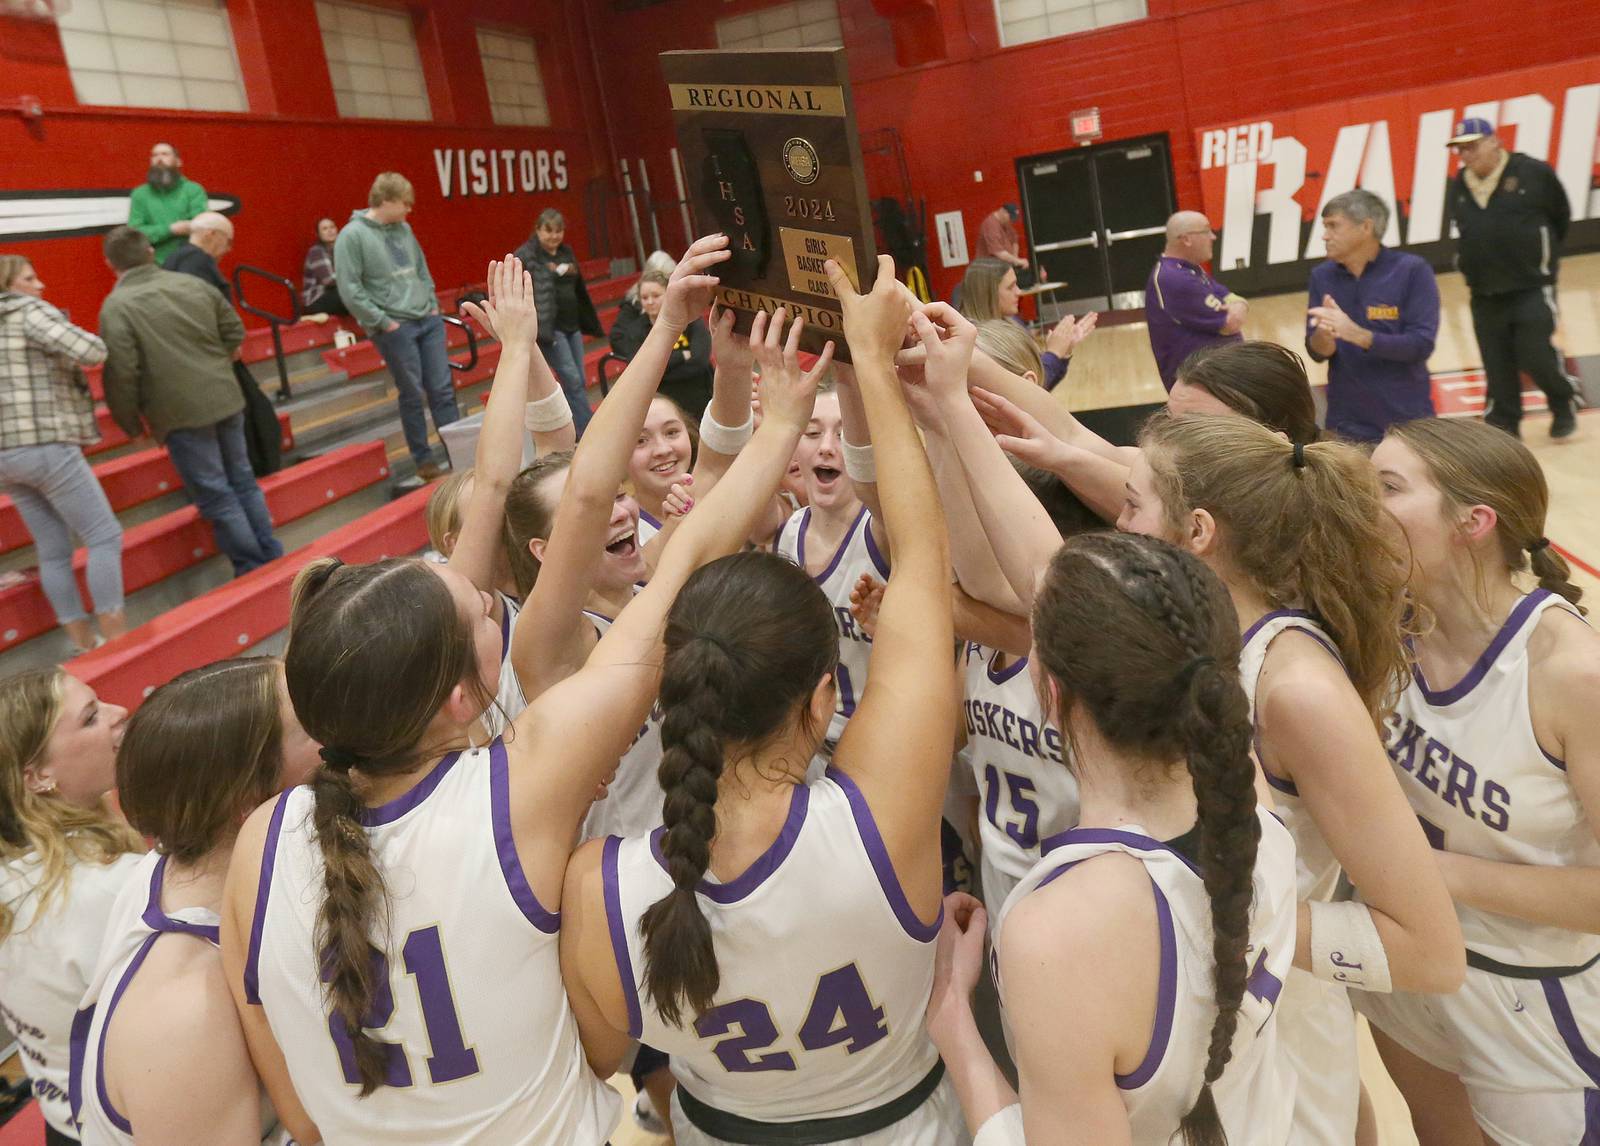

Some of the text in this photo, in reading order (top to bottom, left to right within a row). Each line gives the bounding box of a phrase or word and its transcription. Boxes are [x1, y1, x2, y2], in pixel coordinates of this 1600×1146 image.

[687, 88, 822, 111] REGIONAL
[433, 148, 569, 198] VISITORS
[784, 195, 836, 222] 2024
[804, 237, 828, 256] GIRLS
[807, 279, 830, 296] CLASS
[983, 762, 1041, 851] 15
[691, 959, 892, 1073] 24
